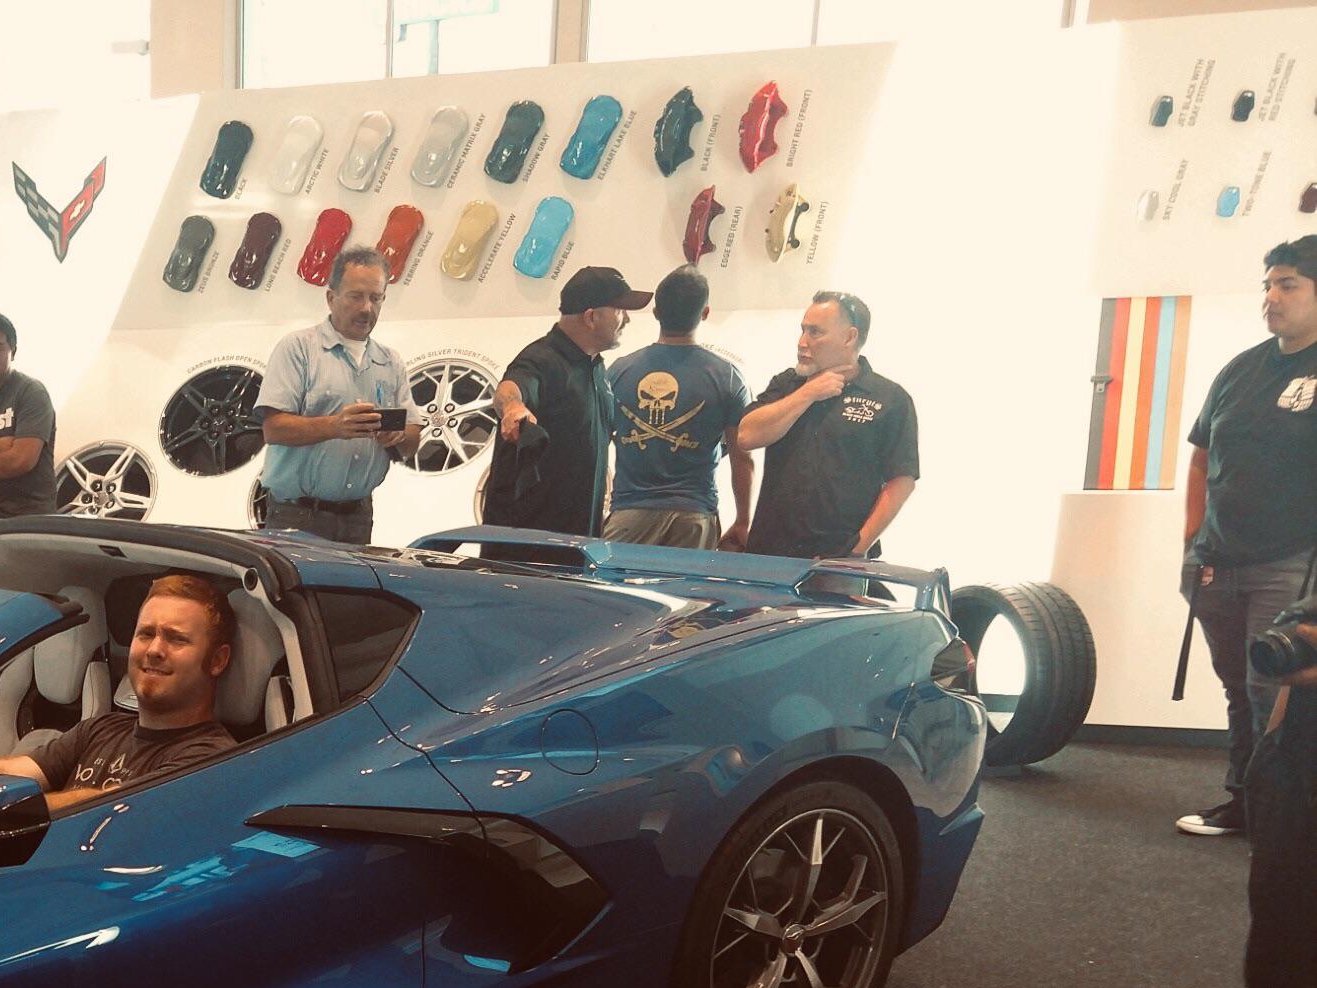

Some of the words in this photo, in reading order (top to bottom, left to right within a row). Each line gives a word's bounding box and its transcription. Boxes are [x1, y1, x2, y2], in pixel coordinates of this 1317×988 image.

[798, 89, 813, 121] (FRONT)
[597, 148, 617, 180] ELKHART
[613, 129, 627, 149] LAKE
[624, 110, 637, 129] BLUE
[700, 147, 712, 172] BLACK
[708, 114, 722, 146] (FRONT)
[794, 122, 803, 140] RED
[447, 157, 465, 189] CERAMIC
[461, 133, 477, 159] MATRIX
[473, 113, 486, 132] GRAY
[522, 153, 540, 182] SHADOW
[538, 133, 551, 152] GRAY
[786, 139, 798, 168] BRIGHT
[305, 170, 320, 194] ARCTIC
[316, 148, 329, 170] WHITE
[374, 170, 388, 193] BLADE
[234, 179, 247, 200] BLACK
[730, 206, 743, 232] (REAR)
[806, 234, 819, 264] YELLOW
[815, 201, 829, 233] (FRONT)
[478, 241, 502, 283] ACCELERATE
[500, 213, 517, 242] YELLOW
[720, 248, 731, 268] EDGE
[725, 232, 735, 249] RED
[265, 276, 276, 292] LONG
[272, 254, 285, 276] BEACH
[282, 238, 292, 255] RED
[403, 257, 421, 287] SEBRING
[418, 231, 434, 258] ORANGE
[551, 259, 566, 281] RAPID
[562, 241, 575, 260] BLUE
[186, 359, 212, 374] CARBON
[427, 349, 451, 357] SILVER
[453, 348, 481, 359] TRIDENT
